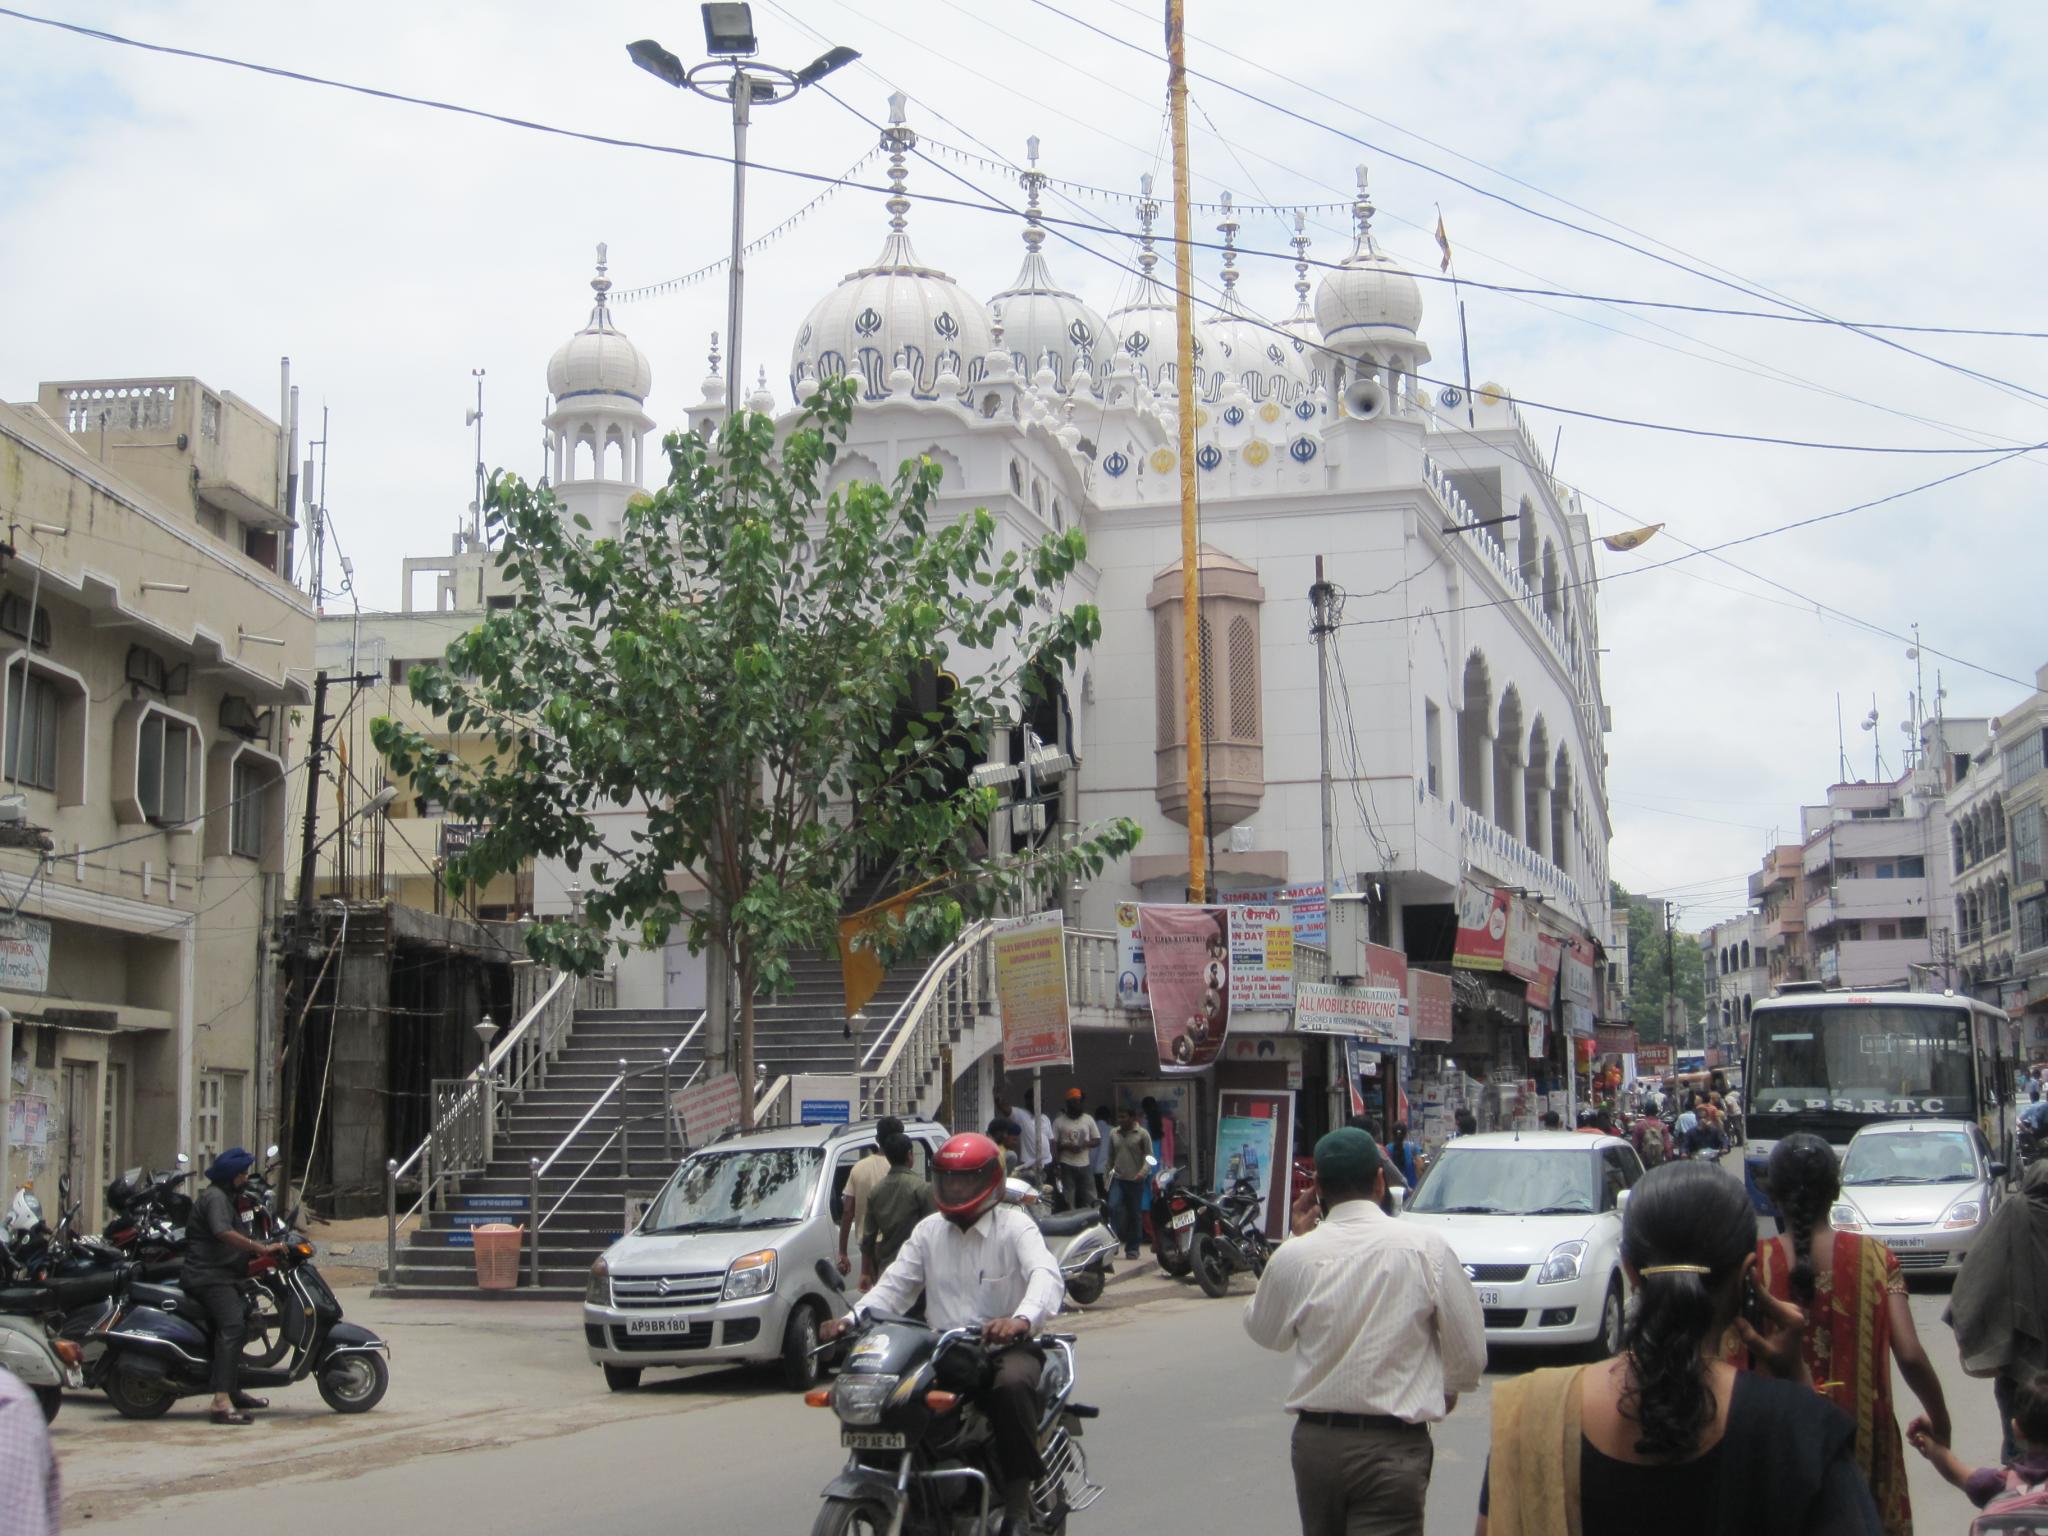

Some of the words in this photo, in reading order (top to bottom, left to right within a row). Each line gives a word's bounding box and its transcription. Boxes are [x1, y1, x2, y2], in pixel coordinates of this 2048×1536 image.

[1222, 891, 1267, 903] SIMRAN
[1273, 886, 1326, 898] SMAGA
[1244, 931, 1264, 941] DAY
[1329, 986, 1398, 1000] COMMUNICATIONS
[1300, 996, 1315, 1011] ALL
[1317, 998, 1349, 1014] MOBILE
[1351, 1000, 1396, 1018] SERVICING
[1638, 1050, 1667, 1059] SPORTS
[631, 1320, 666, 1332] AP9BR
[667, 1319, 686, 1331] 180
[871, 1435, 883, 1448] AE
[885, 1435, 902, 1448] 421
